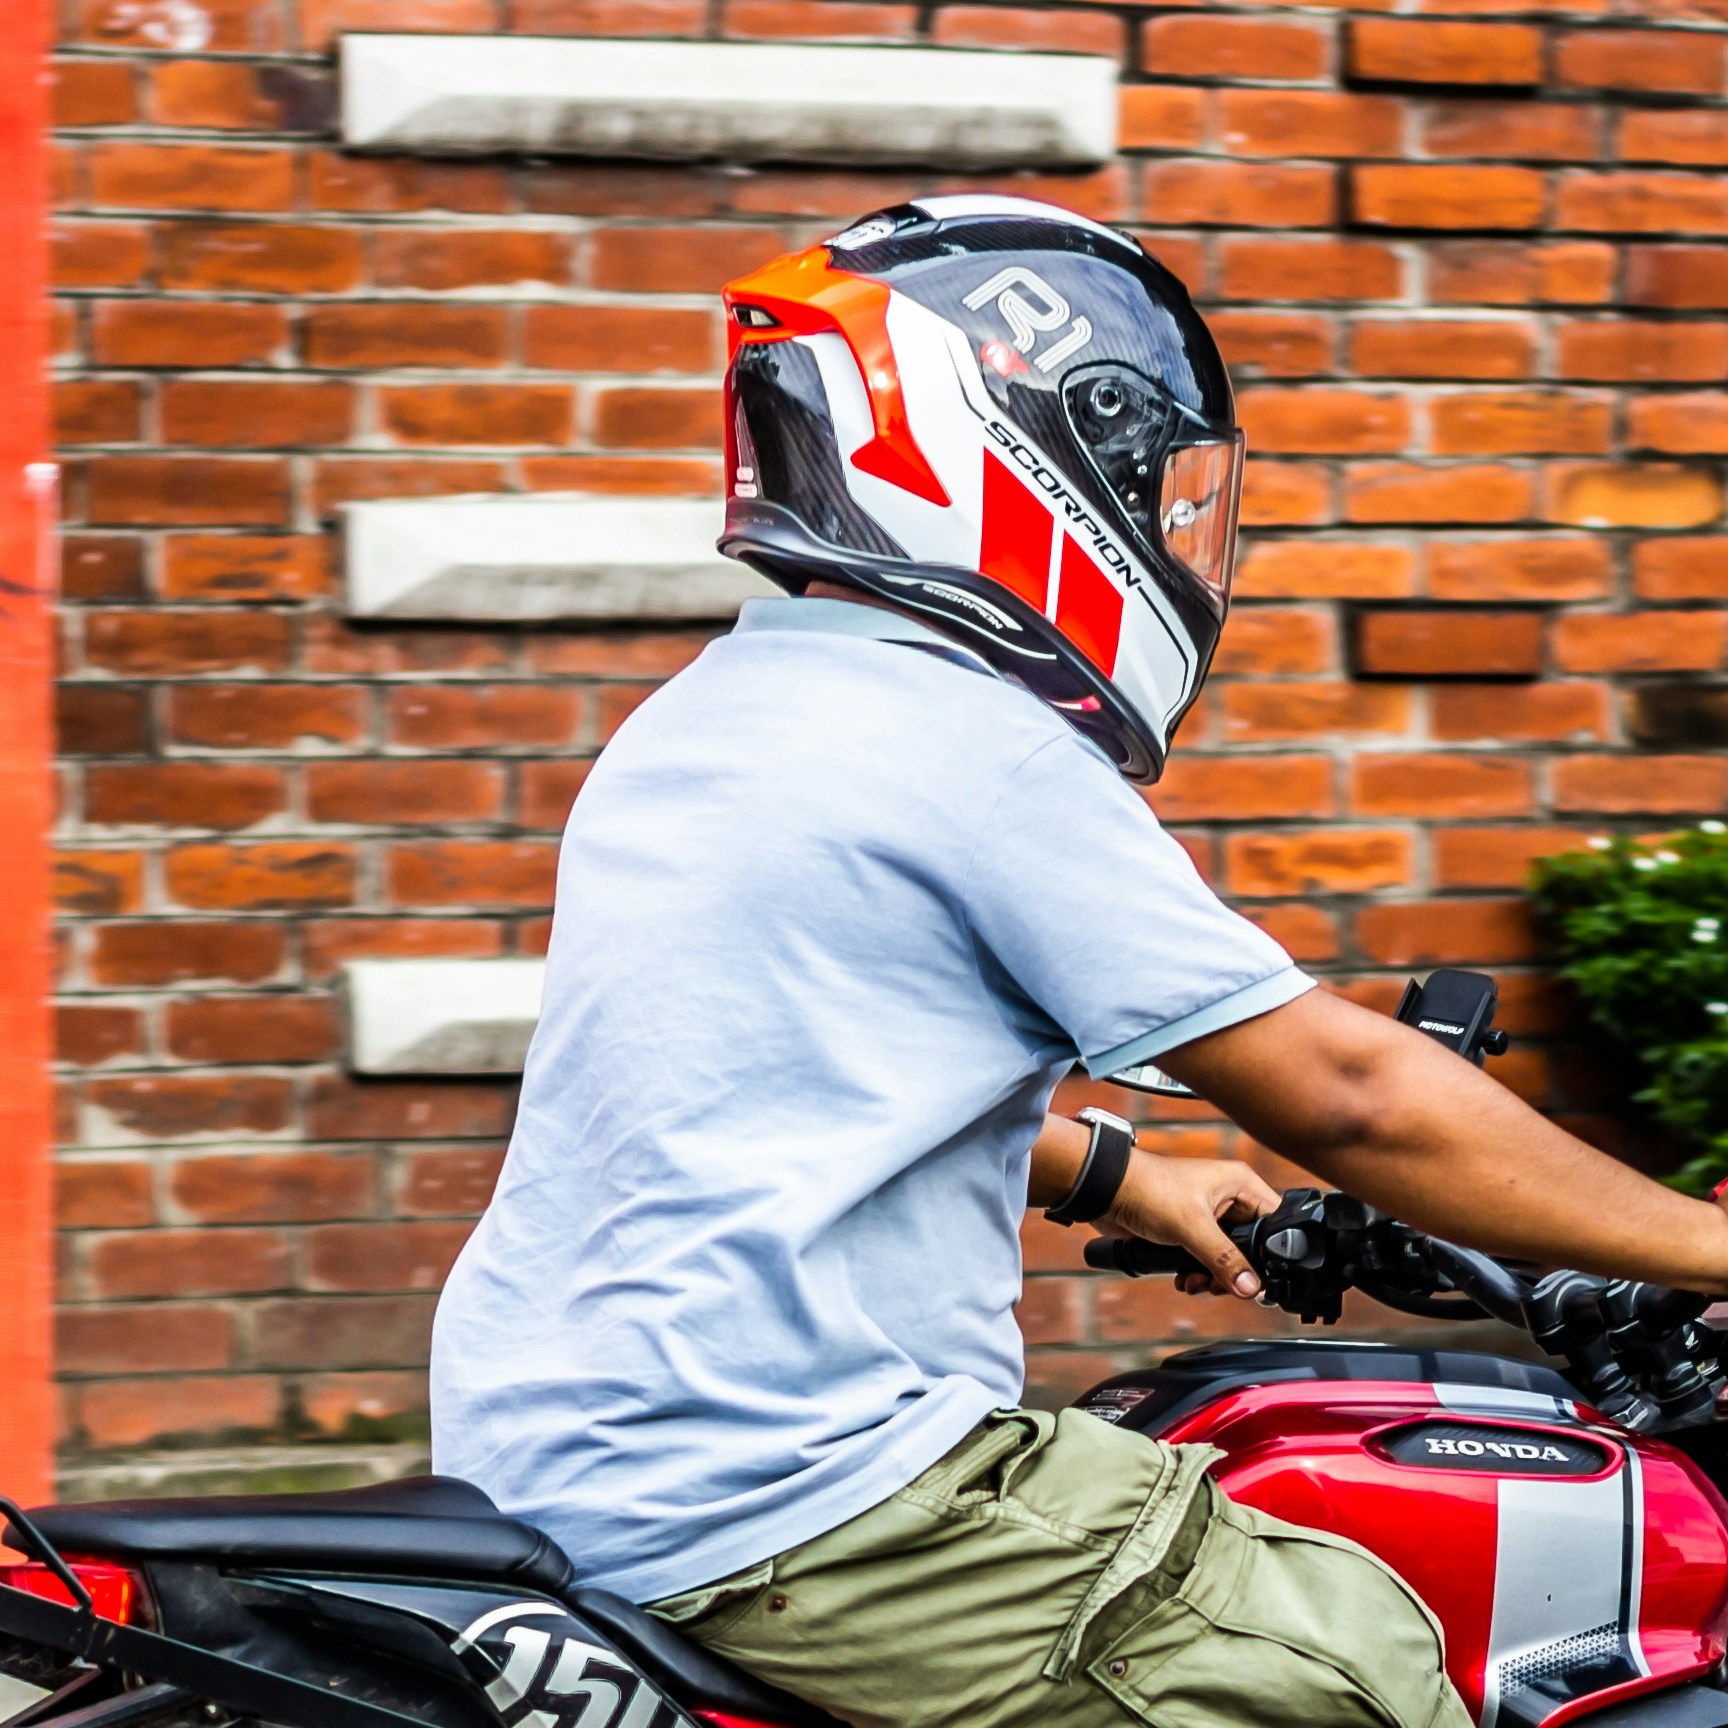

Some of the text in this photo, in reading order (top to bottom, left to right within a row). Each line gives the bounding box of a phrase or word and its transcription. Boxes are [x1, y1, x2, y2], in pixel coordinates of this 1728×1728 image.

[962, 266, 1092, 373] R1
[986, 421, 1141, 587] SCORPION
[1425, 1438, 1570, 1462] HONDA
